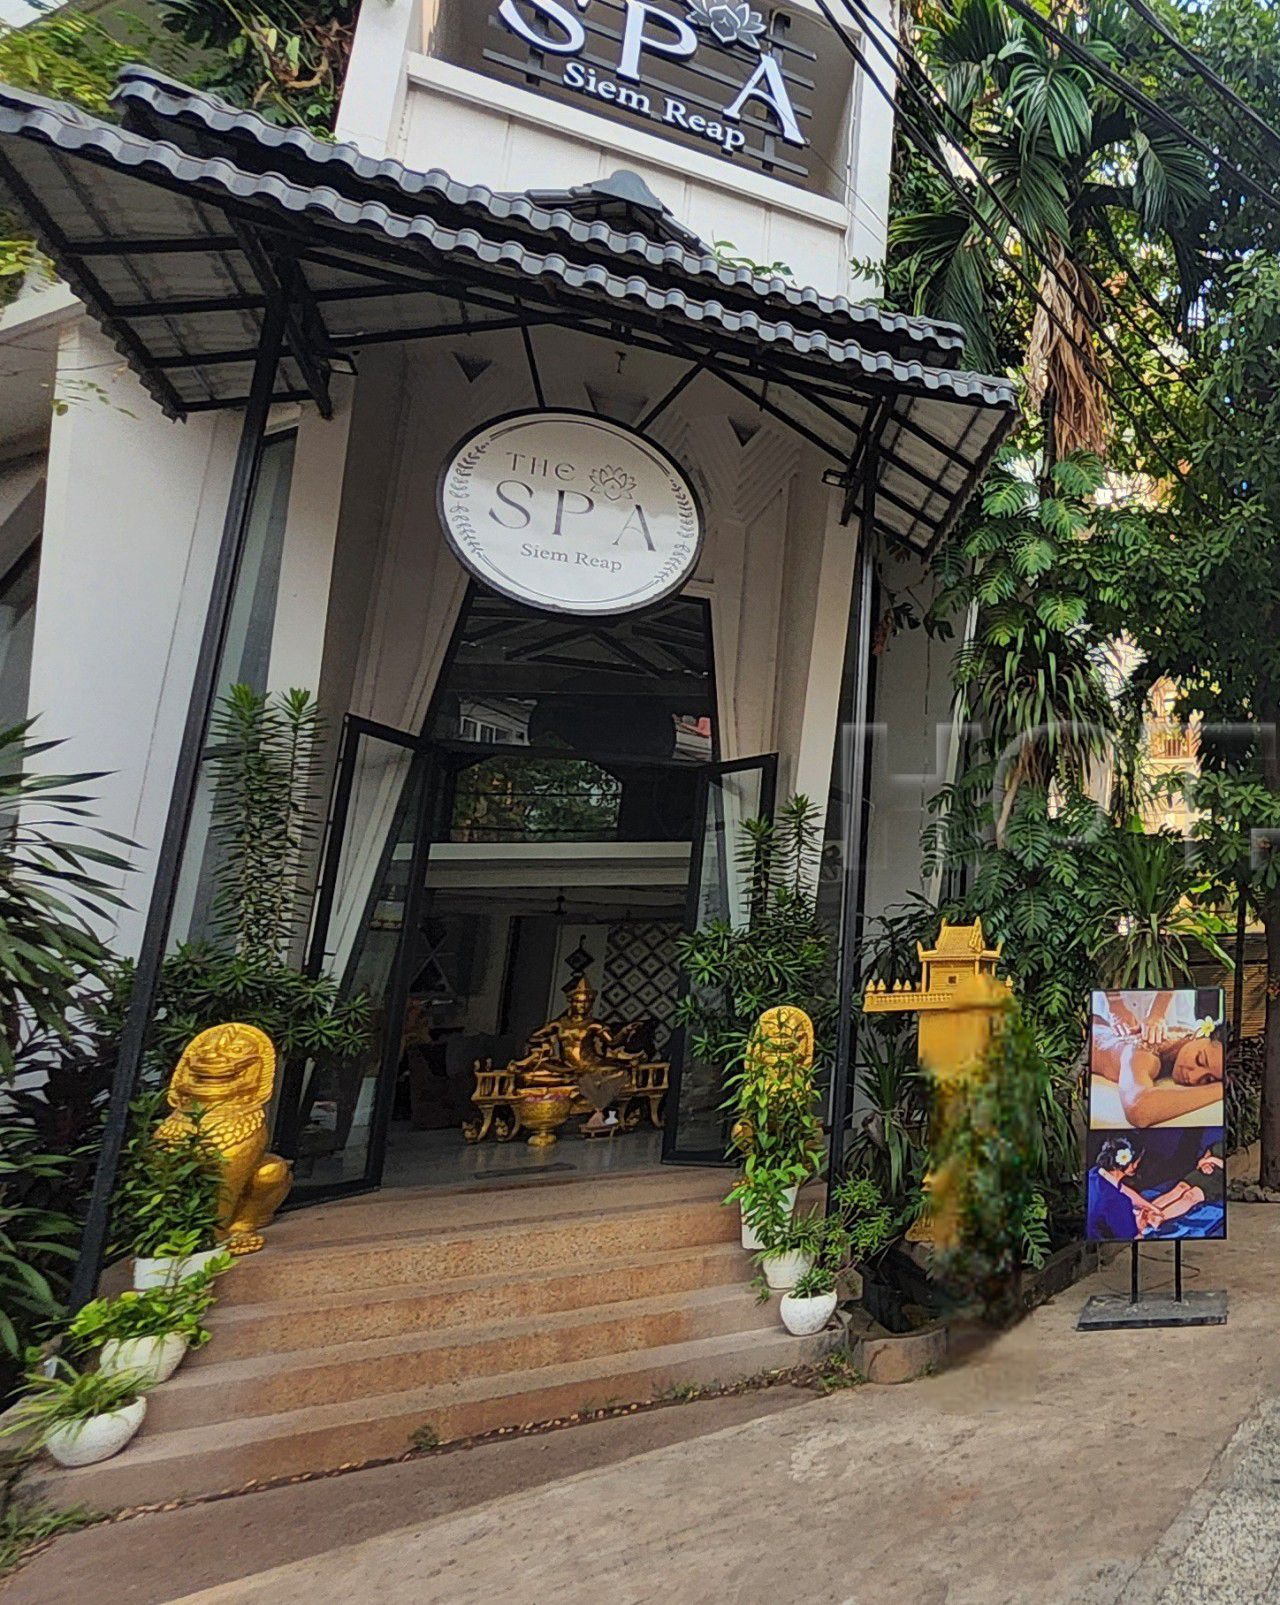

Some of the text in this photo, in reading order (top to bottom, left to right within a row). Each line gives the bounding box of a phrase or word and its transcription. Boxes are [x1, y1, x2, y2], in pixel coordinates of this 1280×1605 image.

[499, 0, 808, 146] SPA
[562, 62, 746, 152] Siem Reap
[506, 452, 576, 482] THE
[488, 479, 656, 552] SPA
[520, 543, 622, 574] Siem Reap
